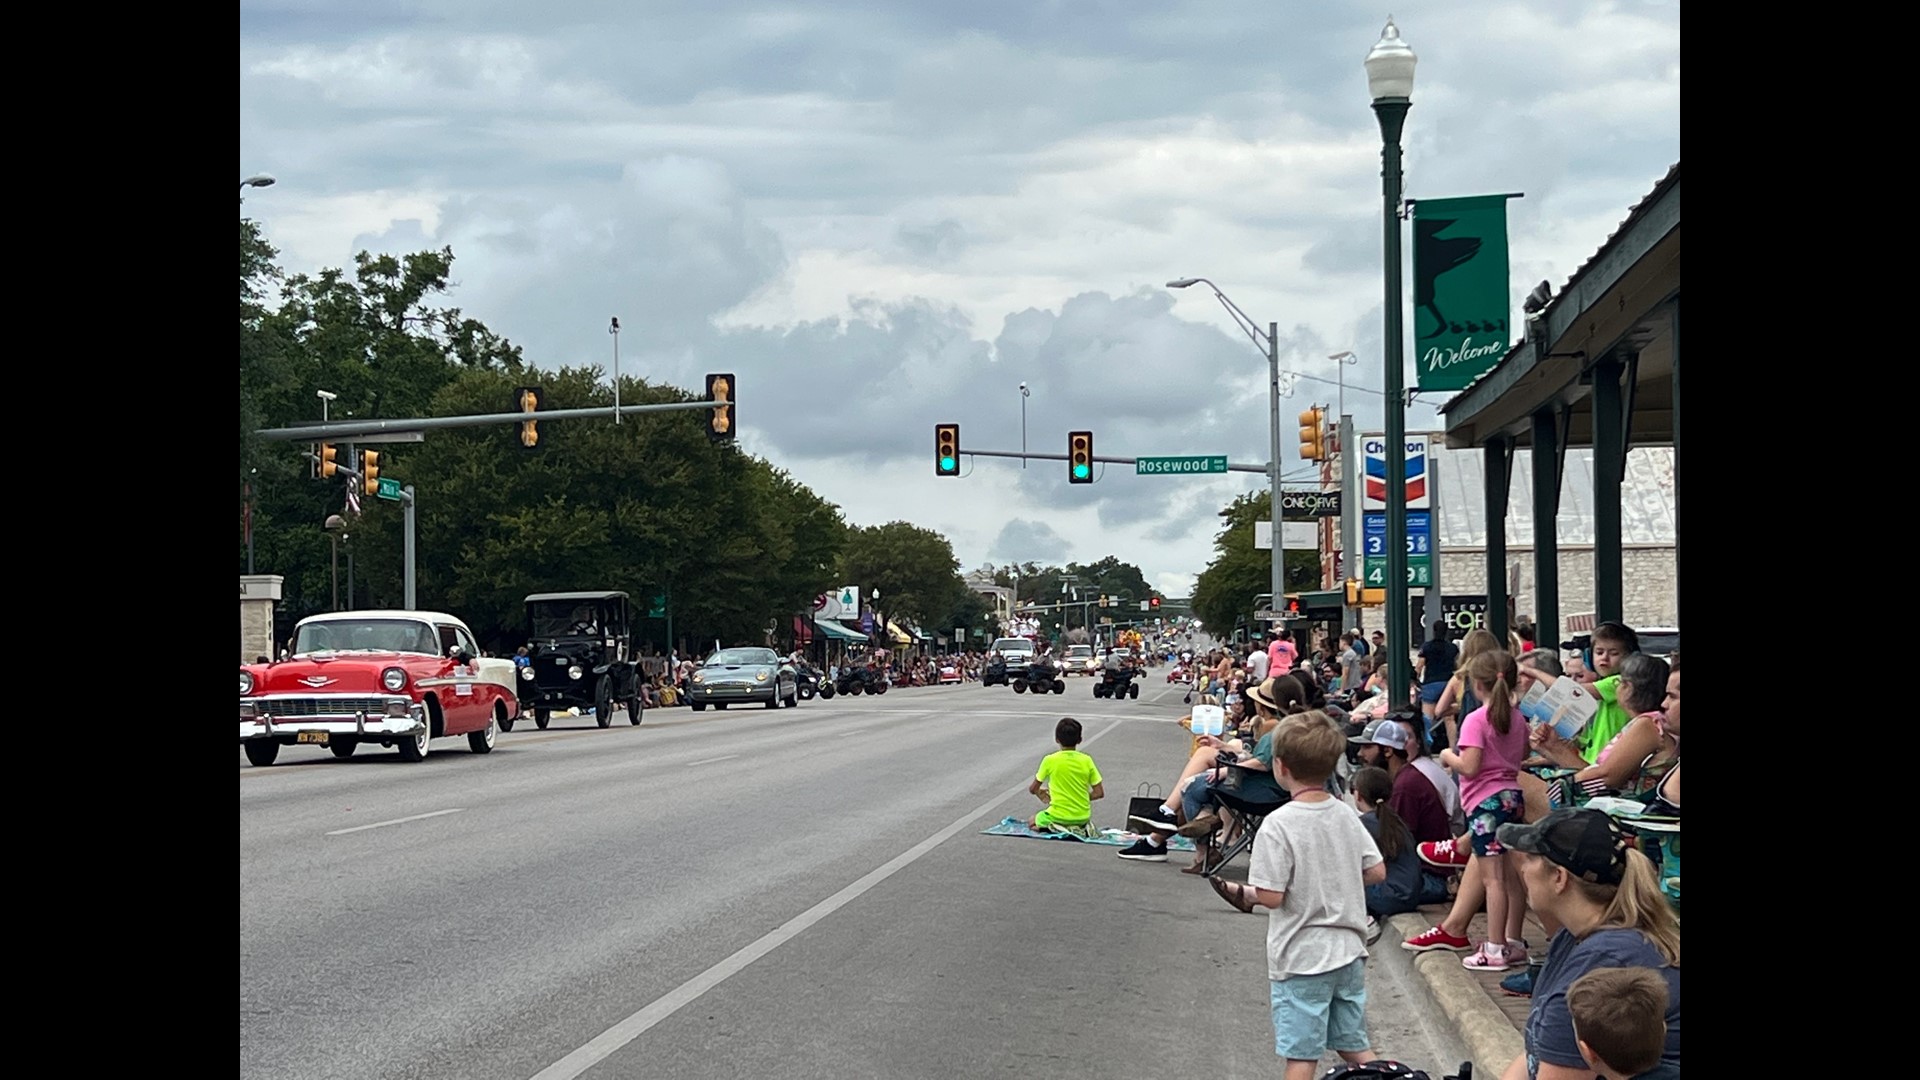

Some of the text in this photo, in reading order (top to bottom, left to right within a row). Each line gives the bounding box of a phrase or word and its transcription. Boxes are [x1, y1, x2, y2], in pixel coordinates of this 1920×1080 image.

[1423, 337, 1502, 371] Welcome
[1366, 441, 1425, 453] Chon
[1138, 458, 1209, 473] Rosewood
